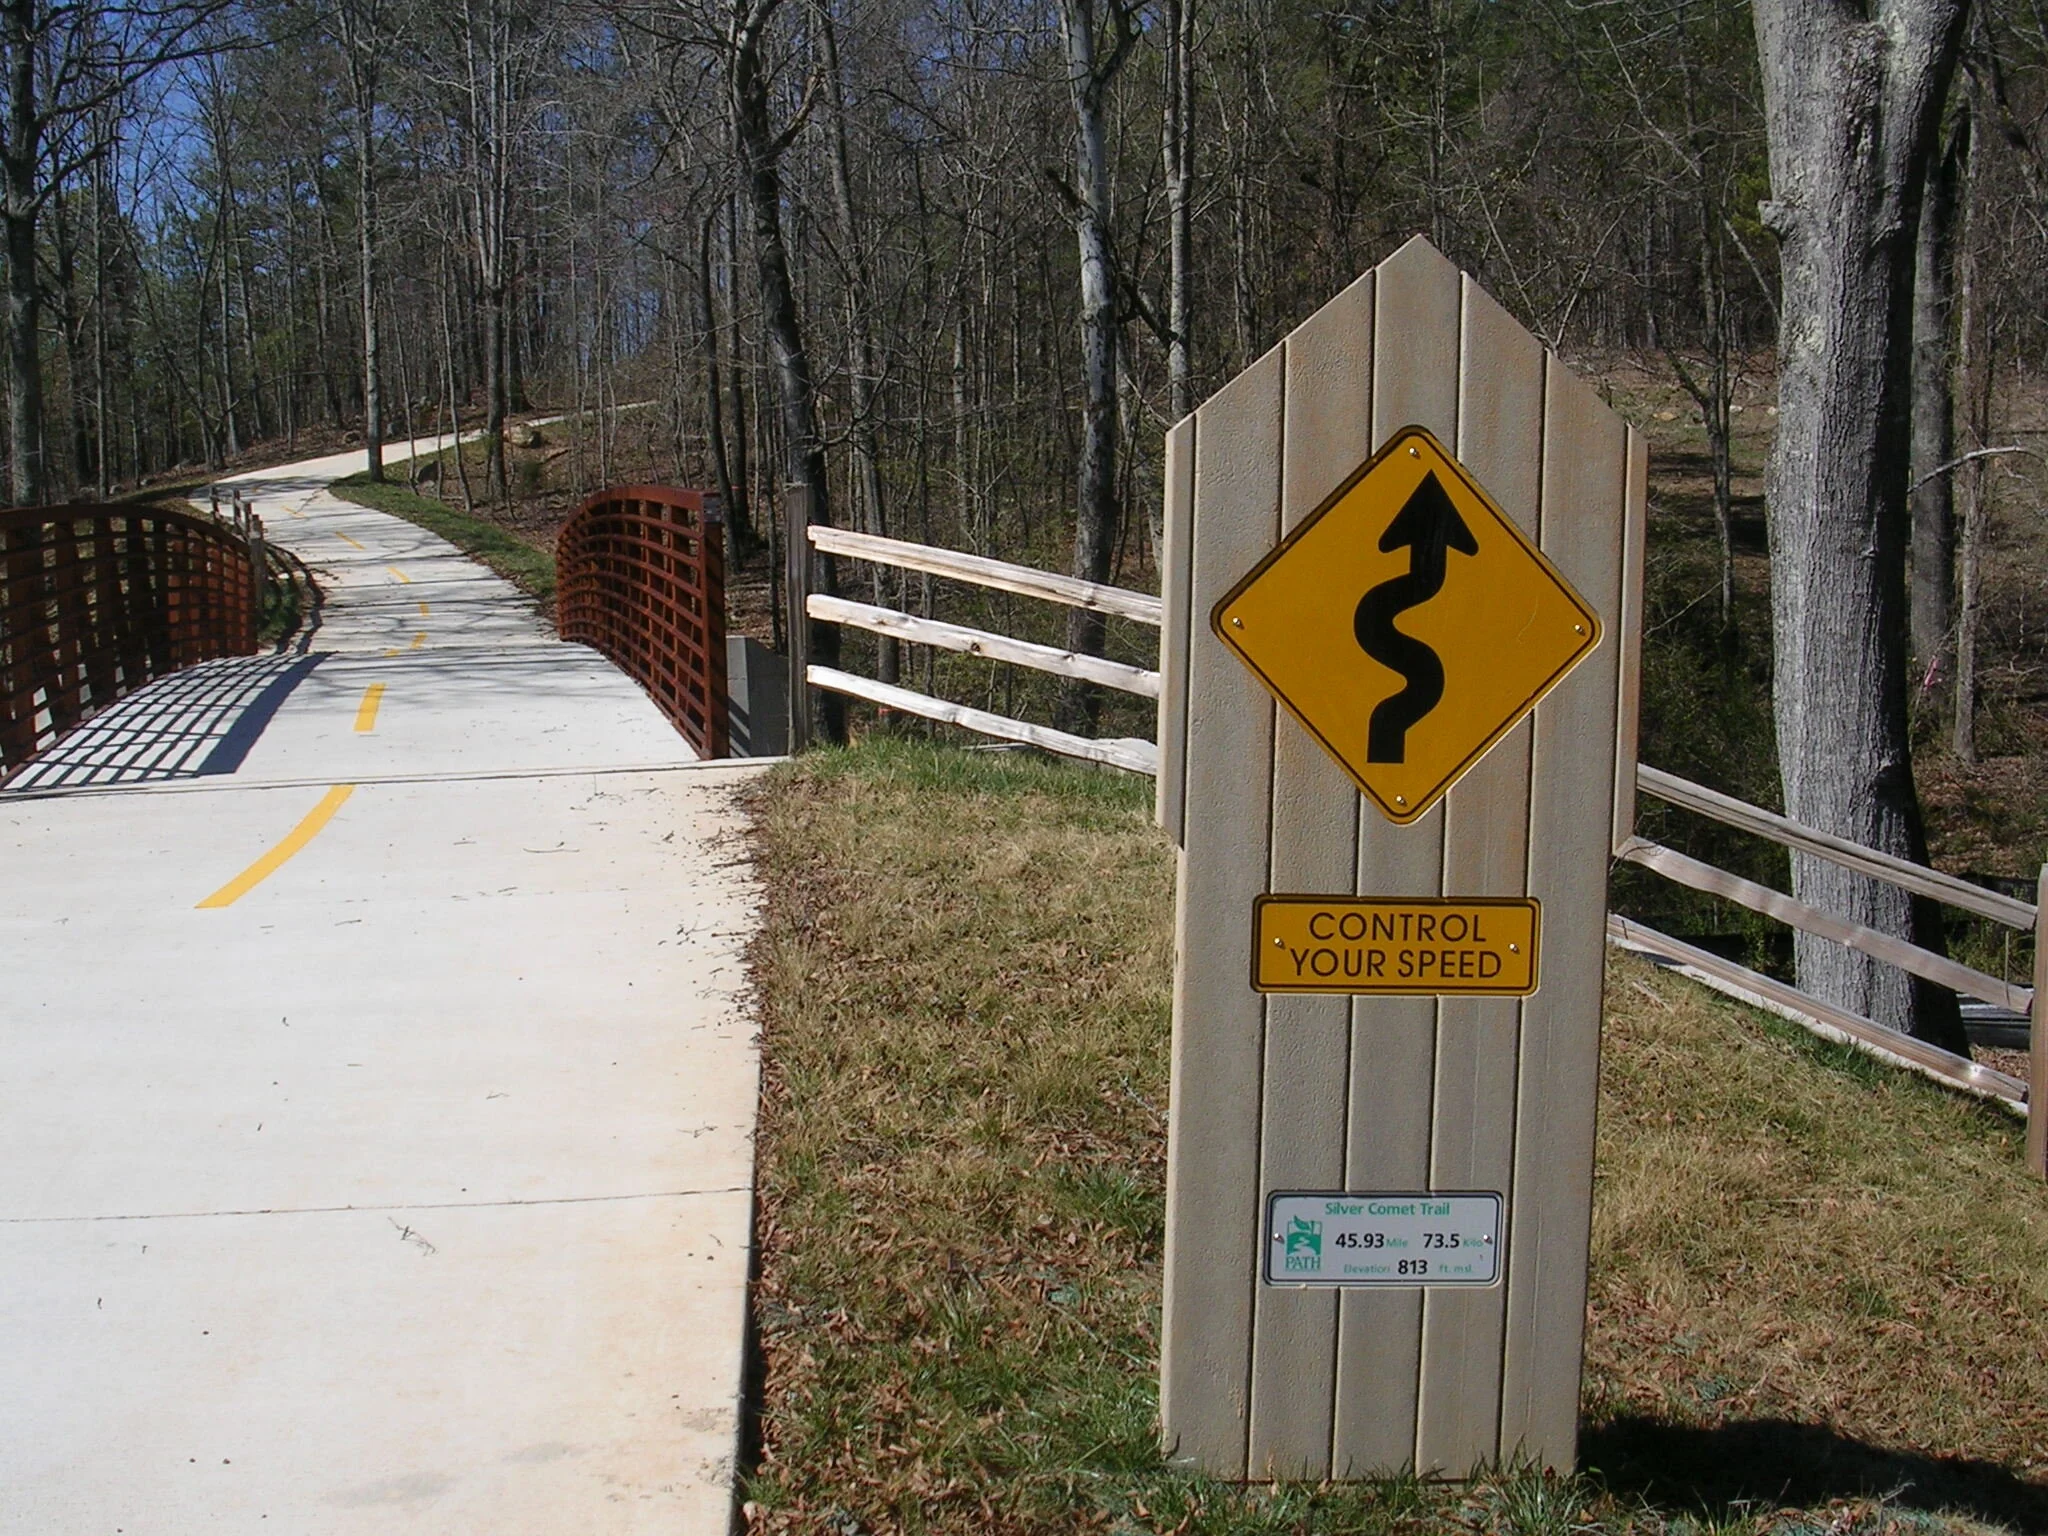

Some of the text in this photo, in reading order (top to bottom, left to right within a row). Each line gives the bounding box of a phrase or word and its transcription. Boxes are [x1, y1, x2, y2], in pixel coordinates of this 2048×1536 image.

[1309, 912, 1487, 942] CONTROL
[1290, 948, 1501, 978] YOUR SPEED
[1325, 1202, 1450, 1216] Silver Comet Trail
[1335, 1233, 1385, 1248] 45.93
[1386, 1238, 1408, 1248] Mile
[1423, 1233, 1460, 1249] 73.5
[1285, 1256, 1321, 1270] PATH
[1343, 1264, 1390, 1274] Elevation
[1398, 1259, 1428, 1275] 813
